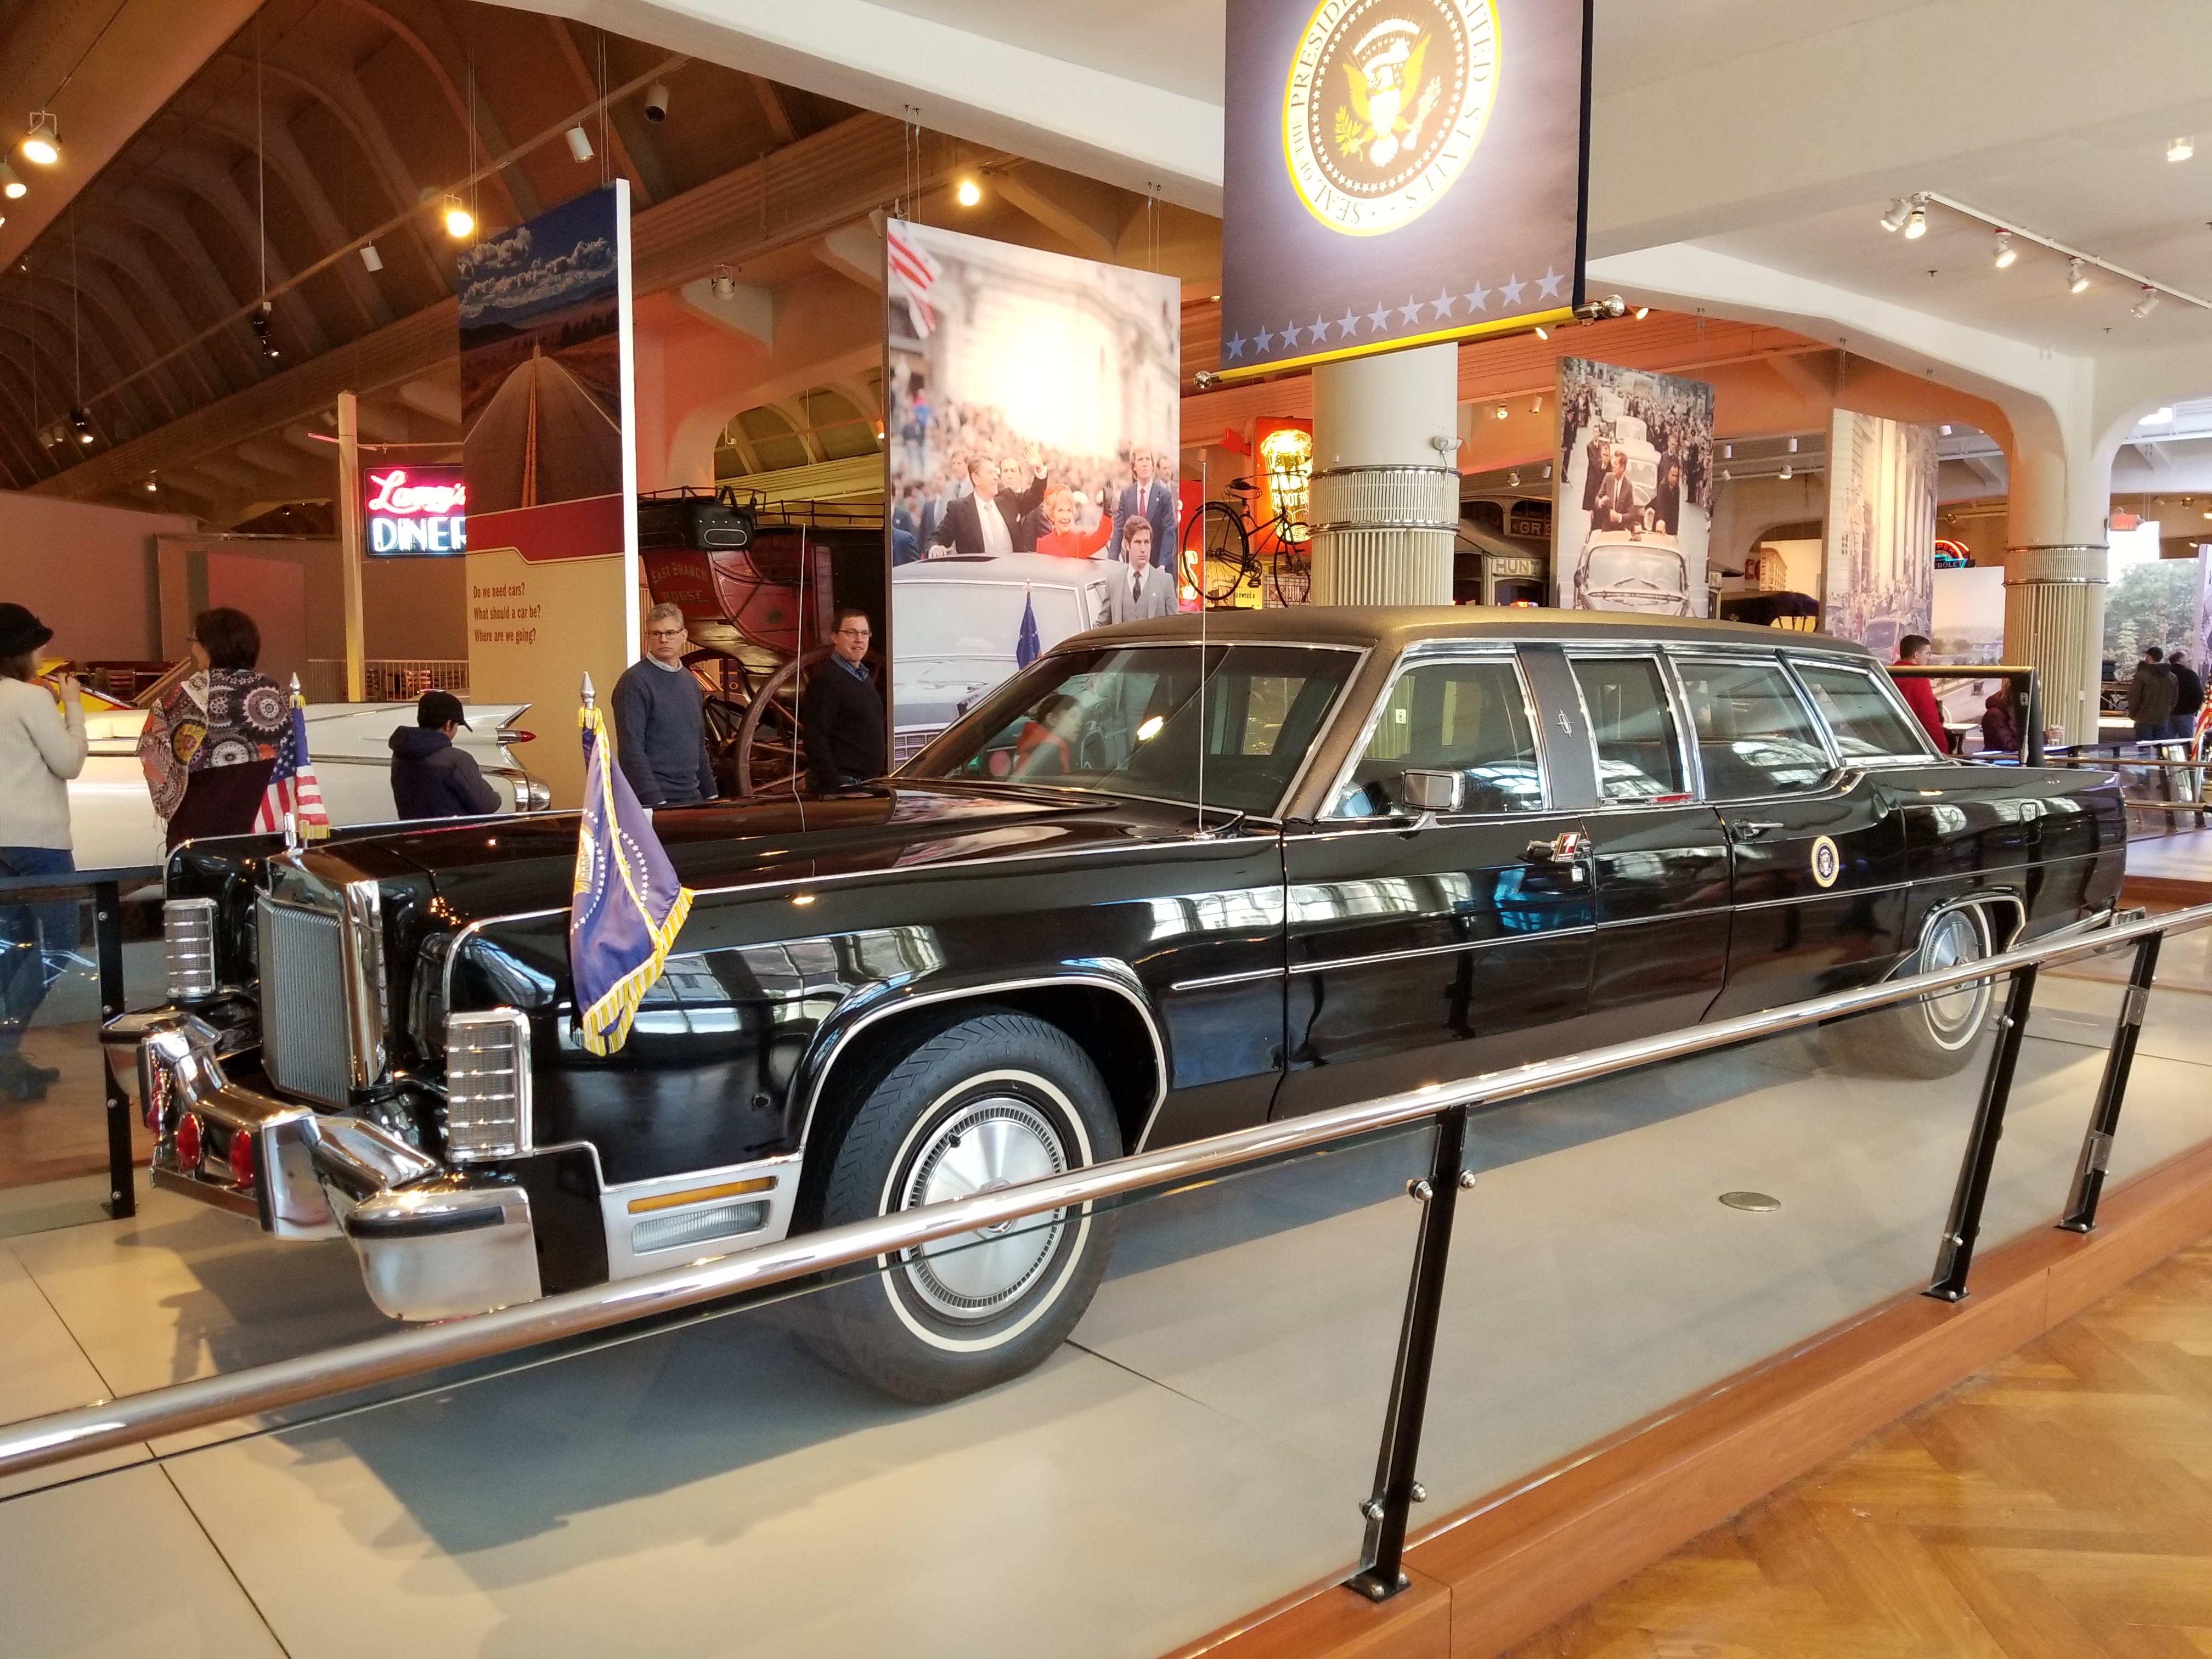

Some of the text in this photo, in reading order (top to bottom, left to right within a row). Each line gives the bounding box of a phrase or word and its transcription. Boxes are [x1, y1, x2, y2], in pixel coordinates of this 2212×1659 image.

[1293, 117, 1305, 157] THE
[1314, 179, 1363, 224] SEAL
[373, 516, 466, 552] DINER
[651, 562, 708, 584] EAST BRANCH
[473, 582, 525, 599] Do we need cars?
[662, 589, 703, 603] HOUSE
[473, 604, 541, 620] What should a car be?
[474, 627, 537, 645] Where are we going?
